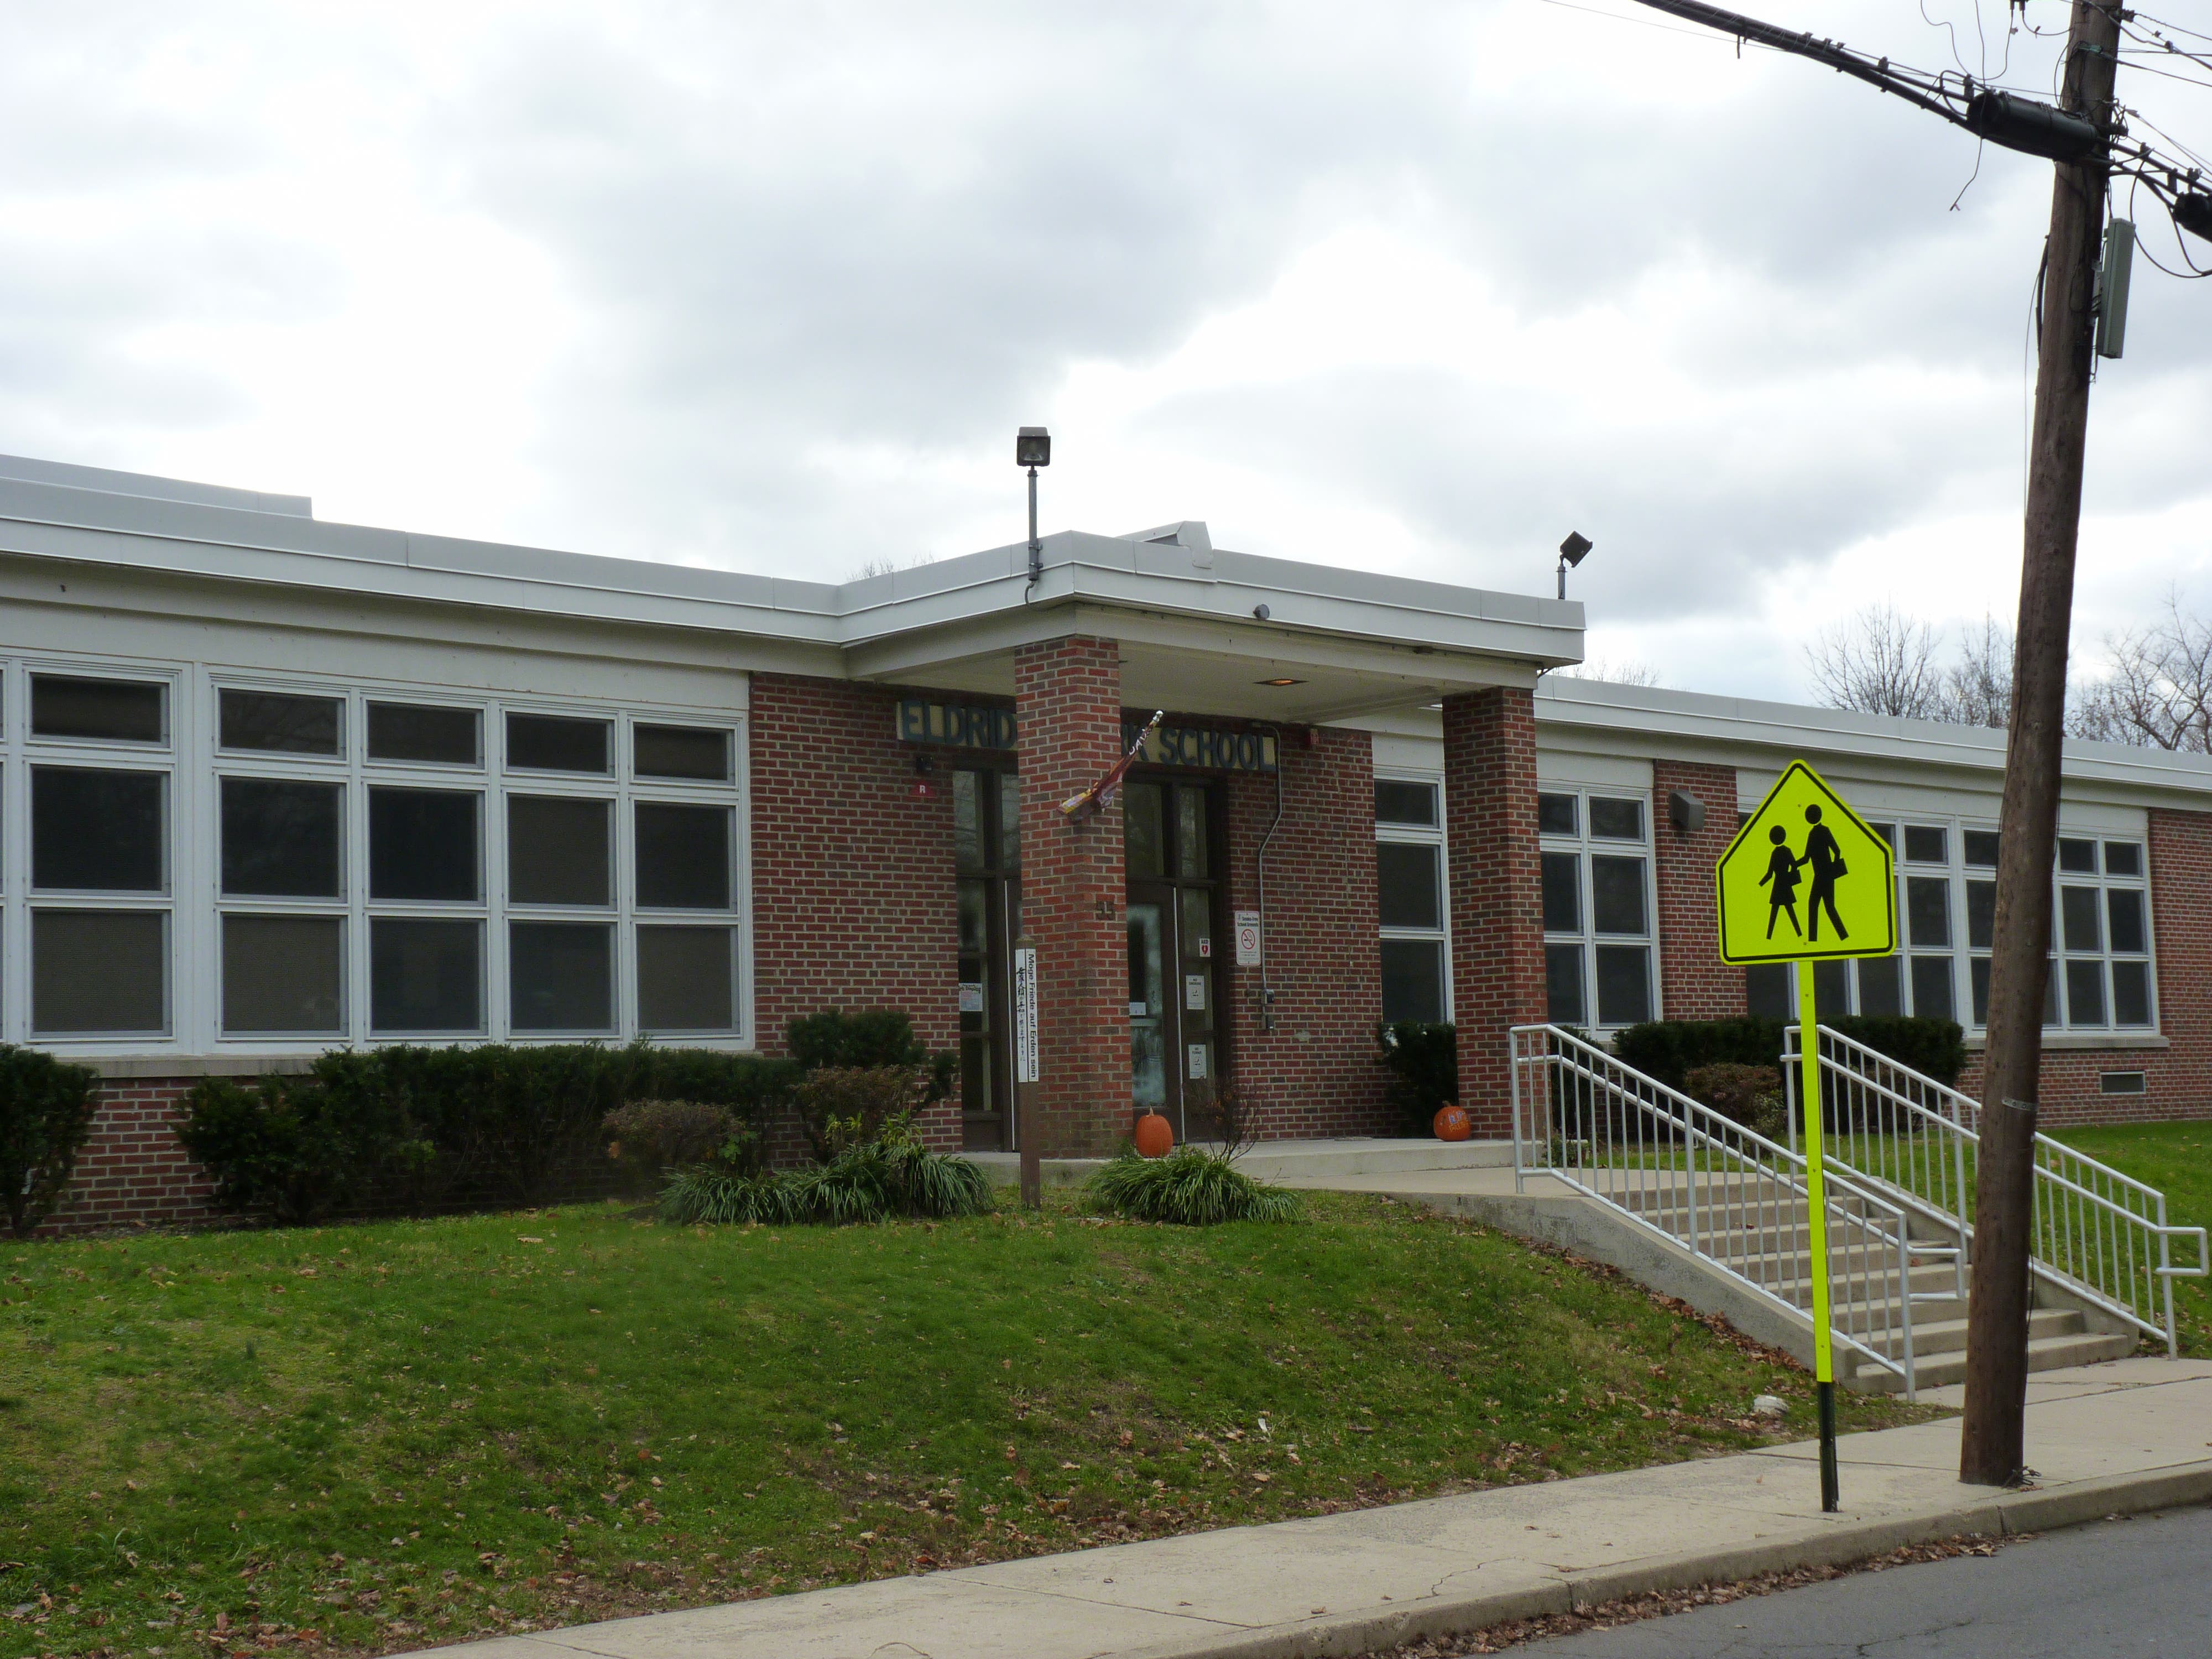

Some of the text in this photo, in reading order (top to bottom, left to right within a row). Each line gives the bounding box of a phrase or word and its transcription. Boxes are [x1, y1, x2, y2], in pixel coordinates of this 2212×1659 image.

[902, 700, 1017, 749] ELDRID
[1159, 726, 1277, 771] SCHOOL
[920, 785, 926, 794] R
